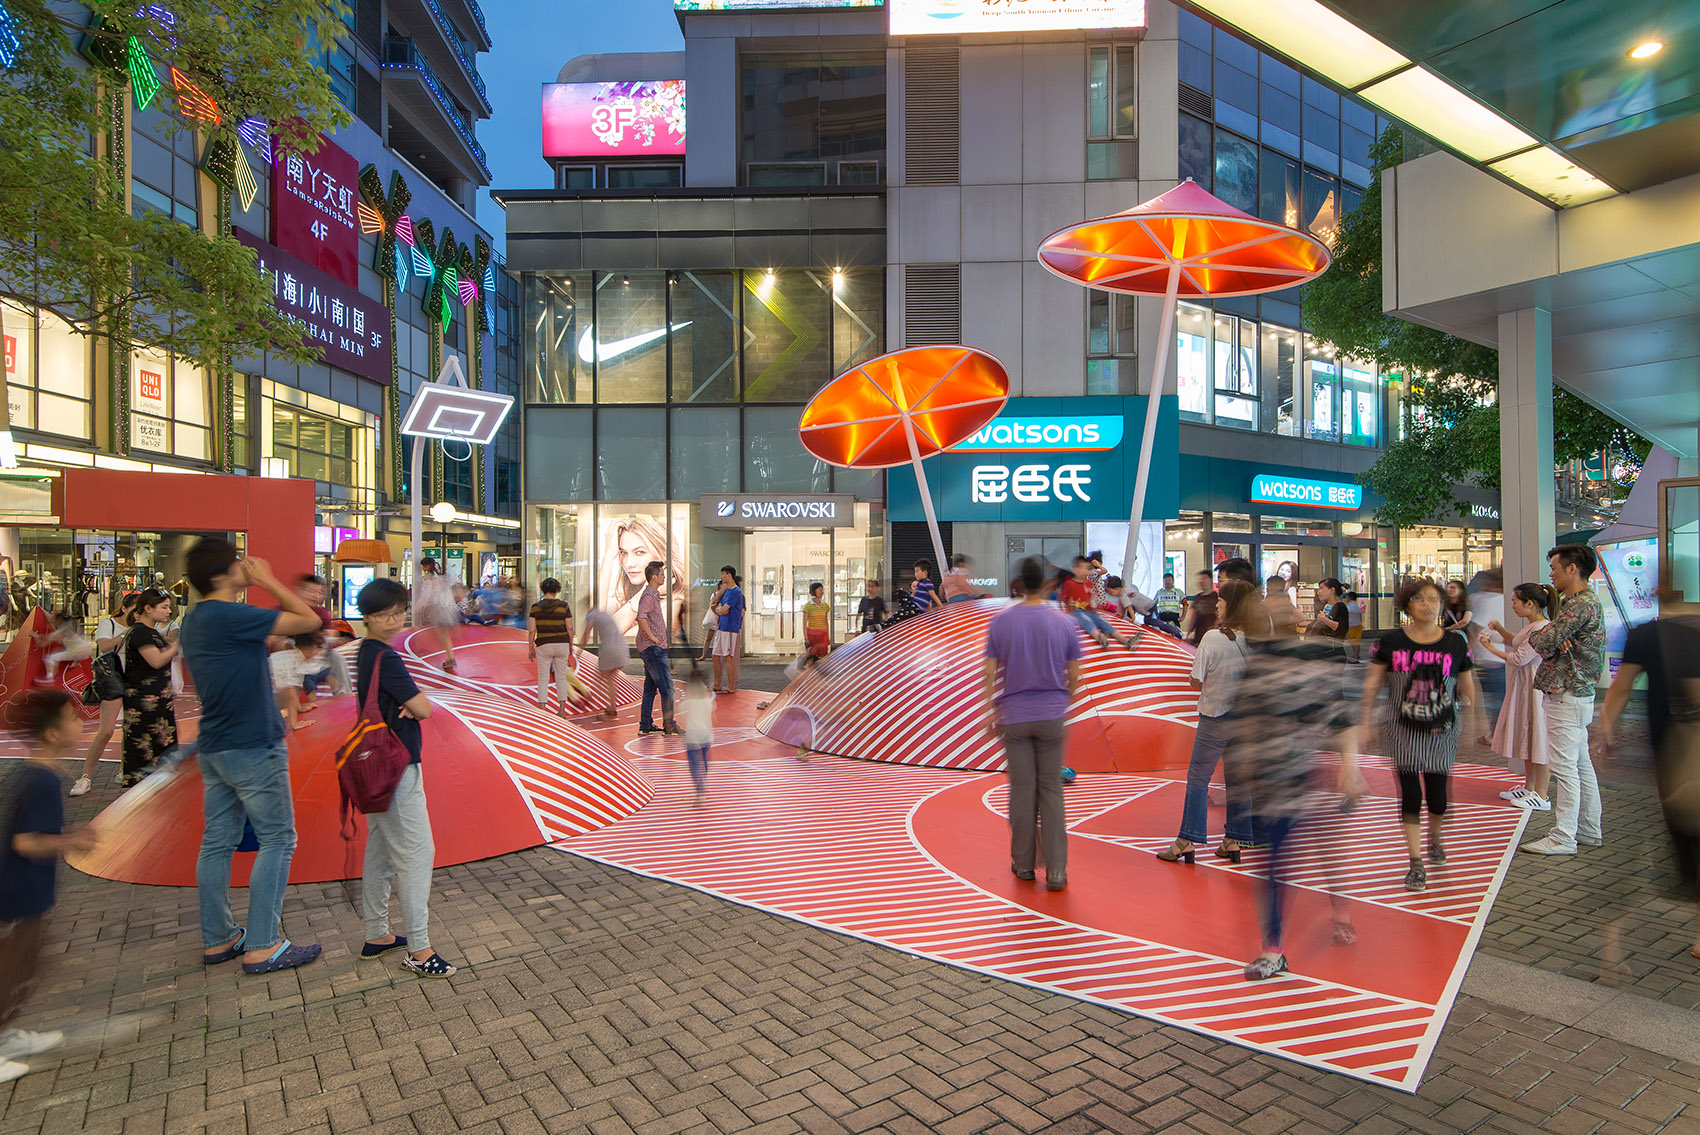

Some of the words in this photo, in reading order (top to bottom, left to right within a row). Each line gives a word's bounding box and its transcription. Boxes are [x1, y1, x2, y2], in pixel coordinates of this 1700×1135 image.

[595, 108, 633, 133] 3F
[286, 152, 354, 218] 南丫天虹
[310, 219, 329, 241] 4F
[340, 336, 364, 358] MIN
[370, 331, 382, 349] 3F
[142, 373, 158, 386] UNI
[142, 385, 160, 397] QLO
[140, 424, 162, 437] 优衣库
[967, 422, 1100, 444] watsons
[972, 464, 1091, 503] 屈臣氏
[1260, 480, 1322, 501] watsons
[1328, 486, 1356, 504] 屈臣氏
[741, 502, 836, 518] SWAROVSKI
